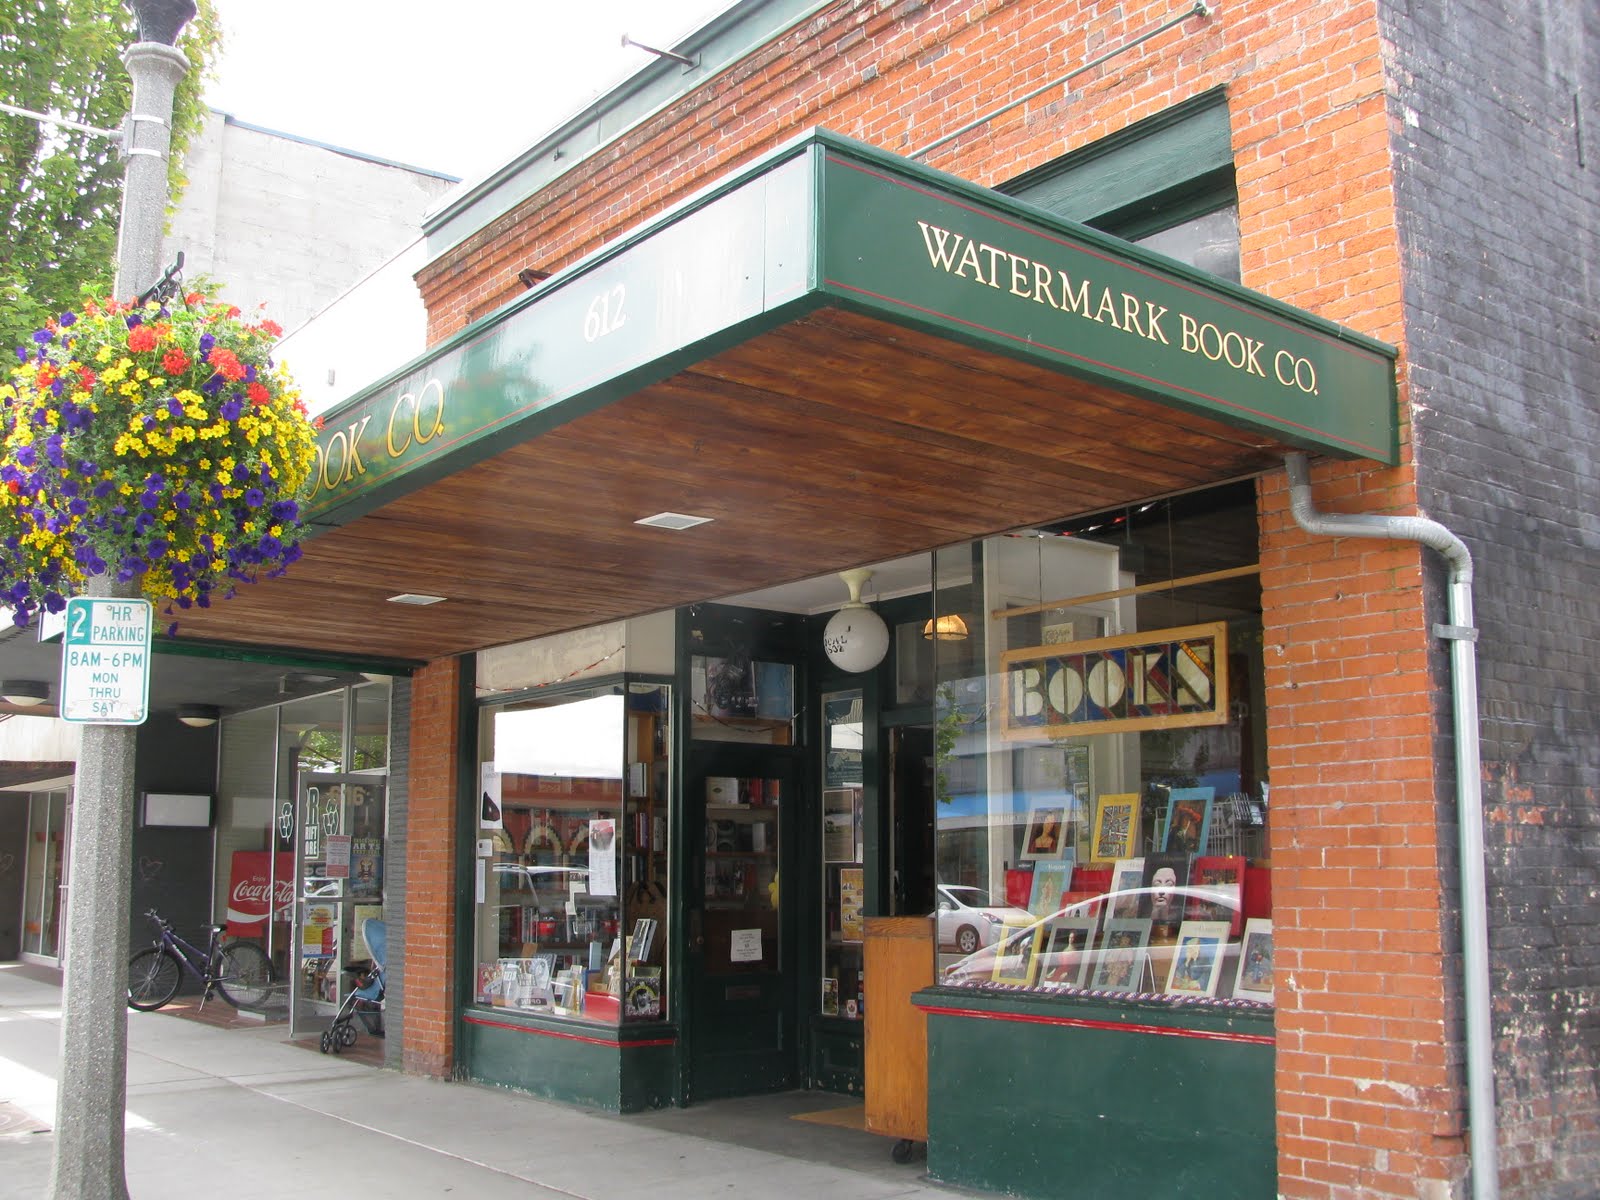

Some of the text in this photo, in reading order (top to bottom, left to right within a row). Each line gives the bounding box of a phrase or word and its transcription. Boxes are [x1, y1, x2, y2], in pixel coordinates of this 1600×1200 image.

[583, 283, 628, 343] 612
[916, 220, 1320, 396] WATERMARK BOOK CO.
[303, 378, 446, 501] OOK CO.
[71, 606, 132, 638] 2 HR
[93, 626, 144, 642] PARKING
[92, 672, 119, 684] MON
[1014, 644, 1211, 717] BOOKS
[89, 687, 121, 699] THRU
[92, 702, 115, 712] SAT
[252, 875, 266, 883] Enjoy
